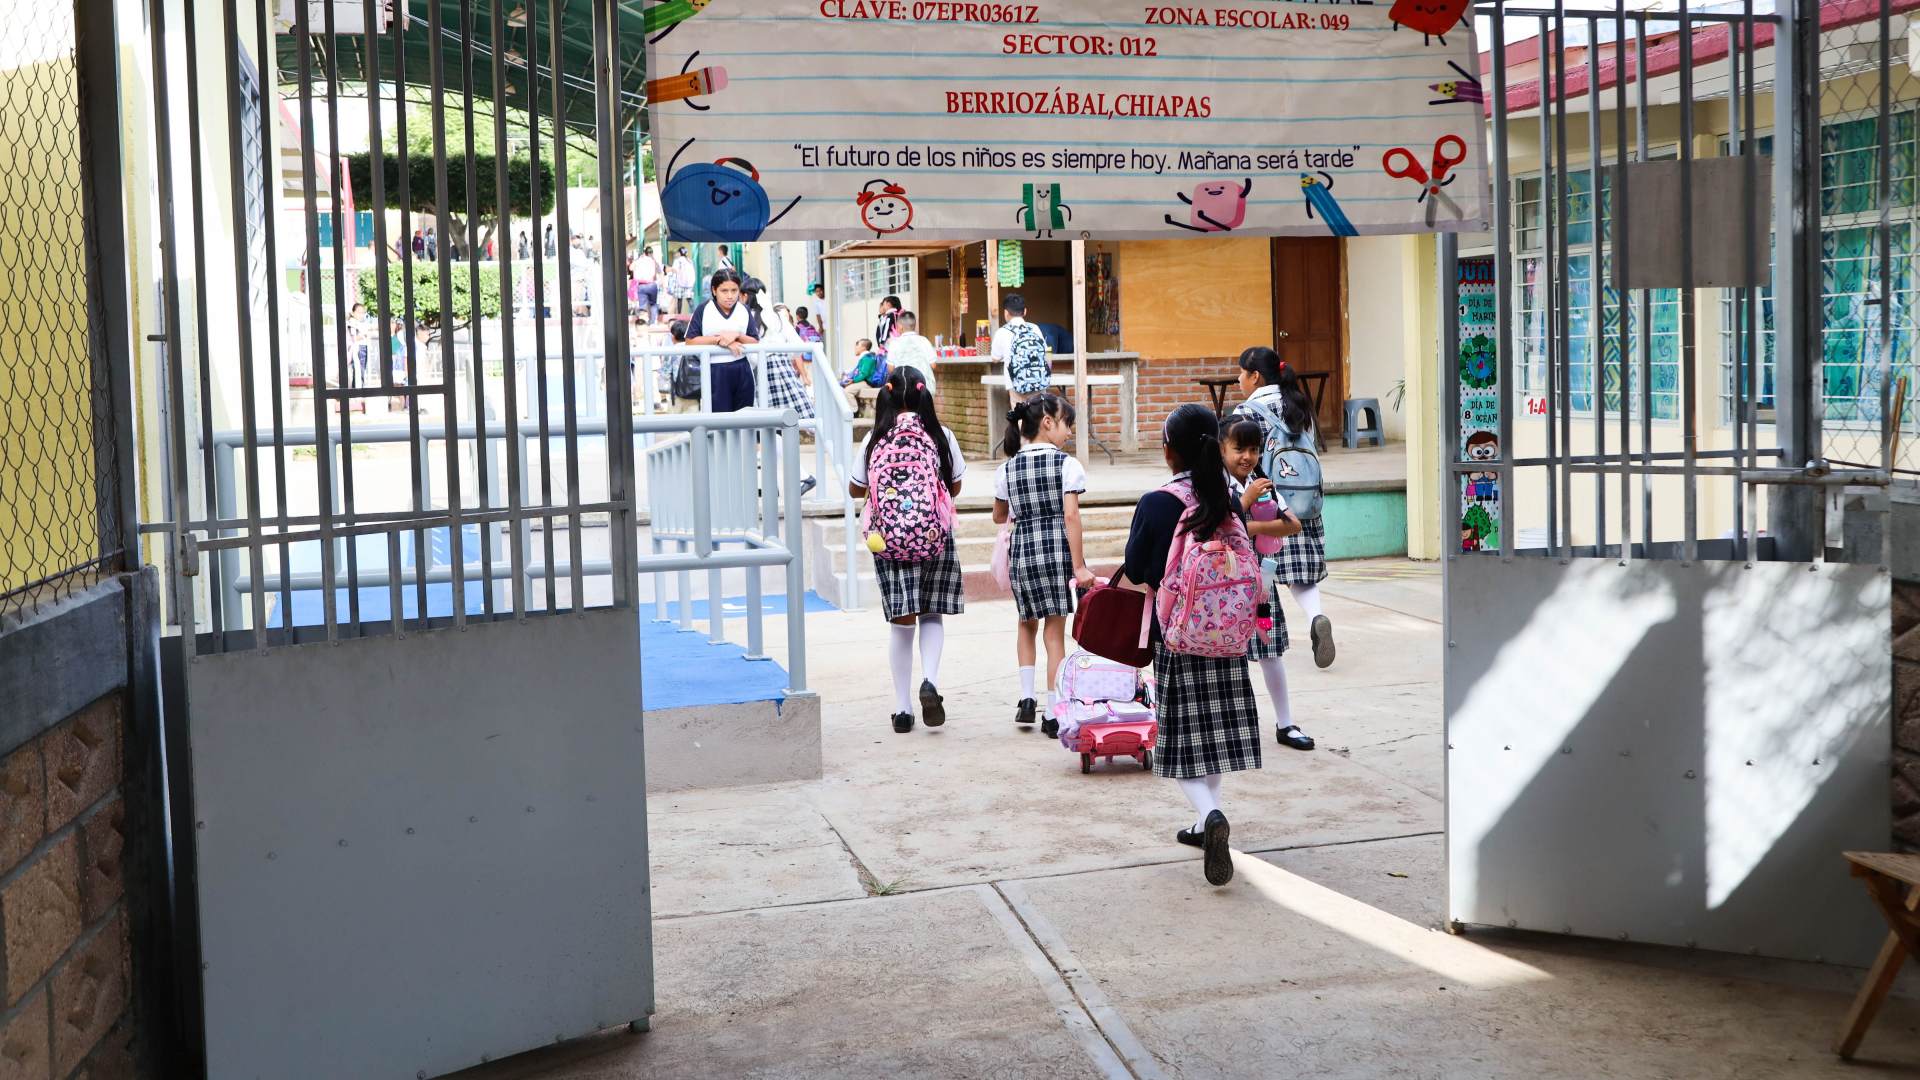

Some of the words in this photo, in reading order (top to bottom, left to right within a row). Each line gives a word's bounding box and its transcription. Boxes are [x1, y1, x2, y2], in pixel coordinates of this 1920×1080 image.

[820, 0, 907, 20] CLAVE:
[912, 2, 1040, 23] 07EPR0361Z
[1145, 7, 1209, 26] ZONA
[1215, 9, 1316, 30] ESCOLAR:
[1320, 12, 1350, 31] 049
[1003, 33, 1113, 56] SECTOR:
[1120, 36, 1157, 57] 012
[945, 86, 1212, 119] BERRIOZÁBAL,CHIAPAS
[827, 145, 889, 167] futuro
[897, 146, 921, 167] de
[928, 146, 956, 168] los
[963, 147, 1016, 168] niños
[1023, 152, 1045, 168] es
[1052, 149, 1126, 174] siempre
[1131, 149, 1171, 175] hoy.
[1178, 150, 1251, 170] Mañana
[1257, 148, 1299, 170] será
[1464, 410, 1471, 420] 8
[1485, 400, 1496, 410] DE
